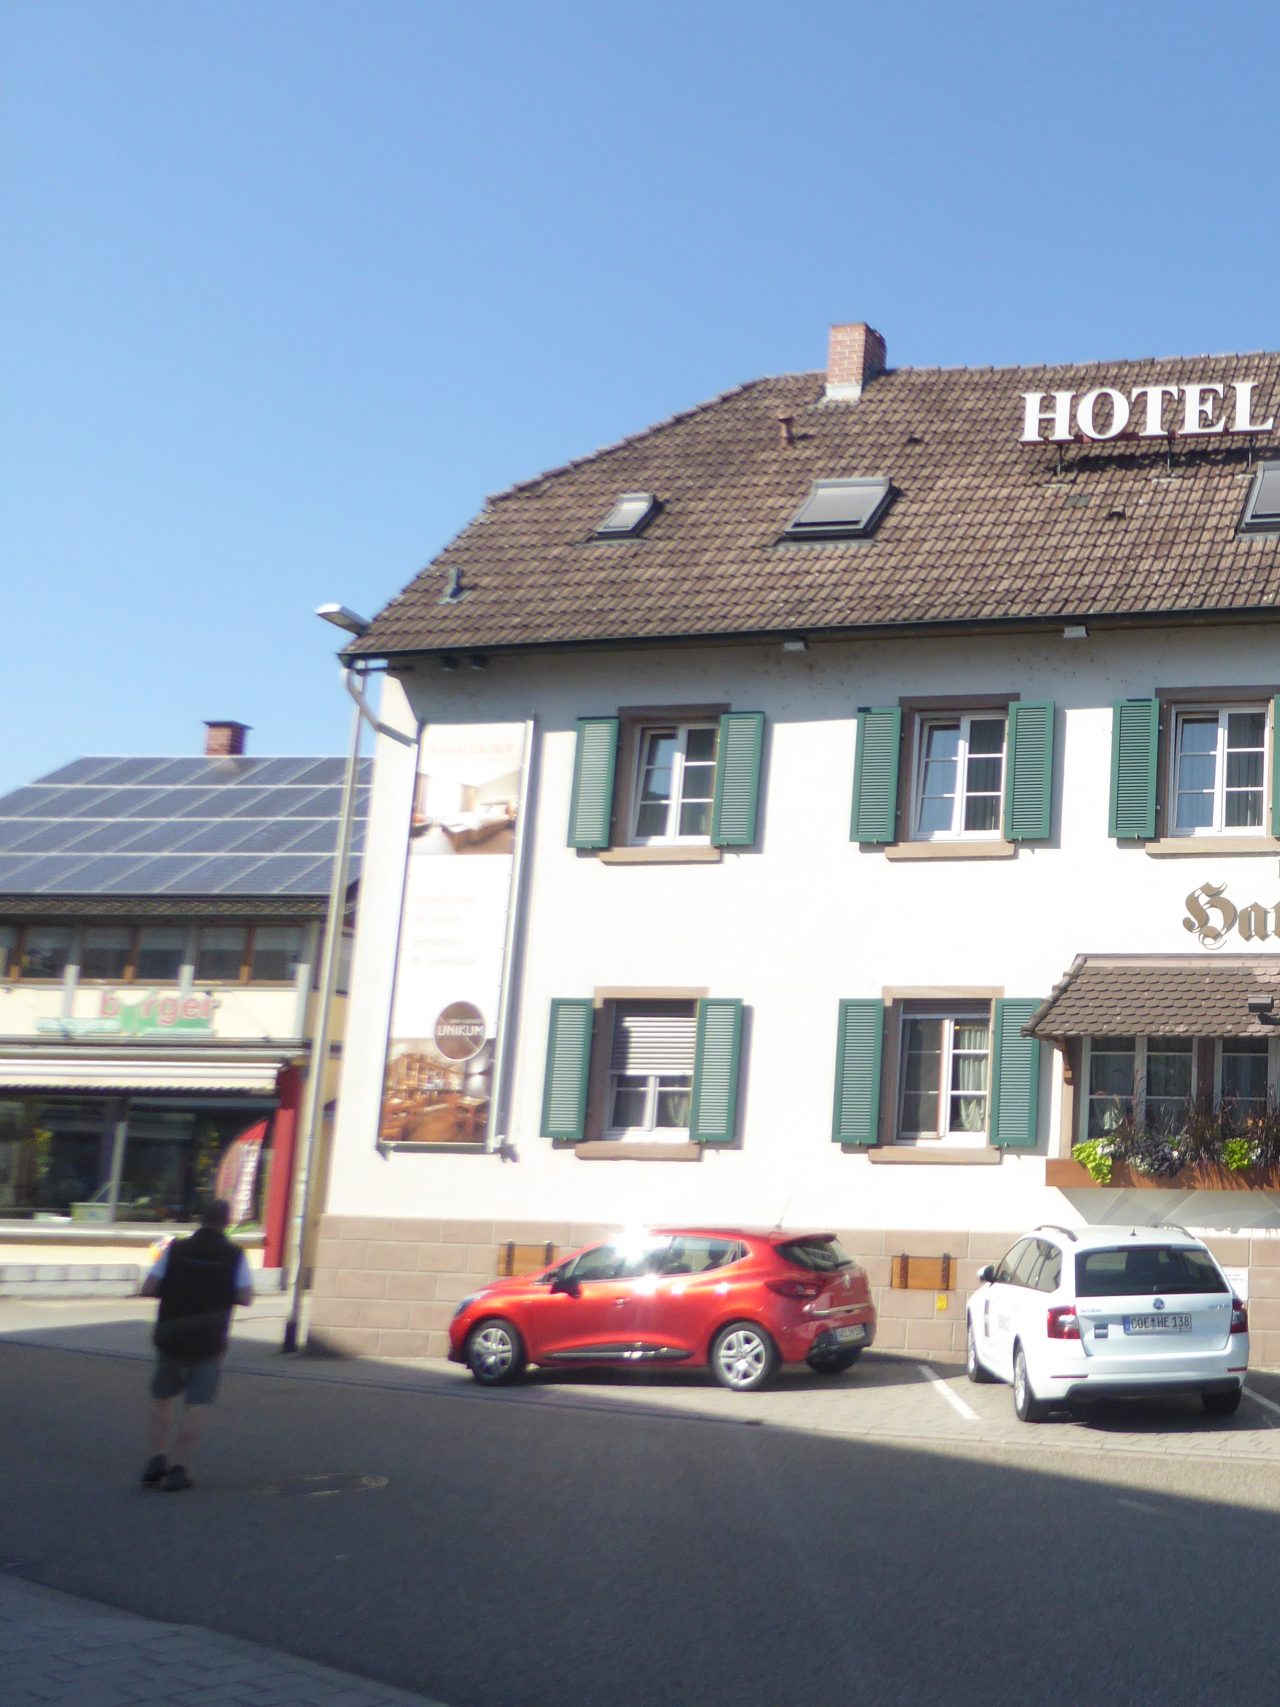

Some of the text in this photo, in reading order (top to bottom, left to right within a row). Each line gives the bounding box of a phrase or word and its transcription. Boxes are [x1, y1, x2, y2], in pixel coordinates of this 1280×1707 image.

[1018, 381, 1274, 443] HOTEL
[438, 1024, 484, 1036] UNIKUM
[1172, 1315, 1190, 1327] 138
